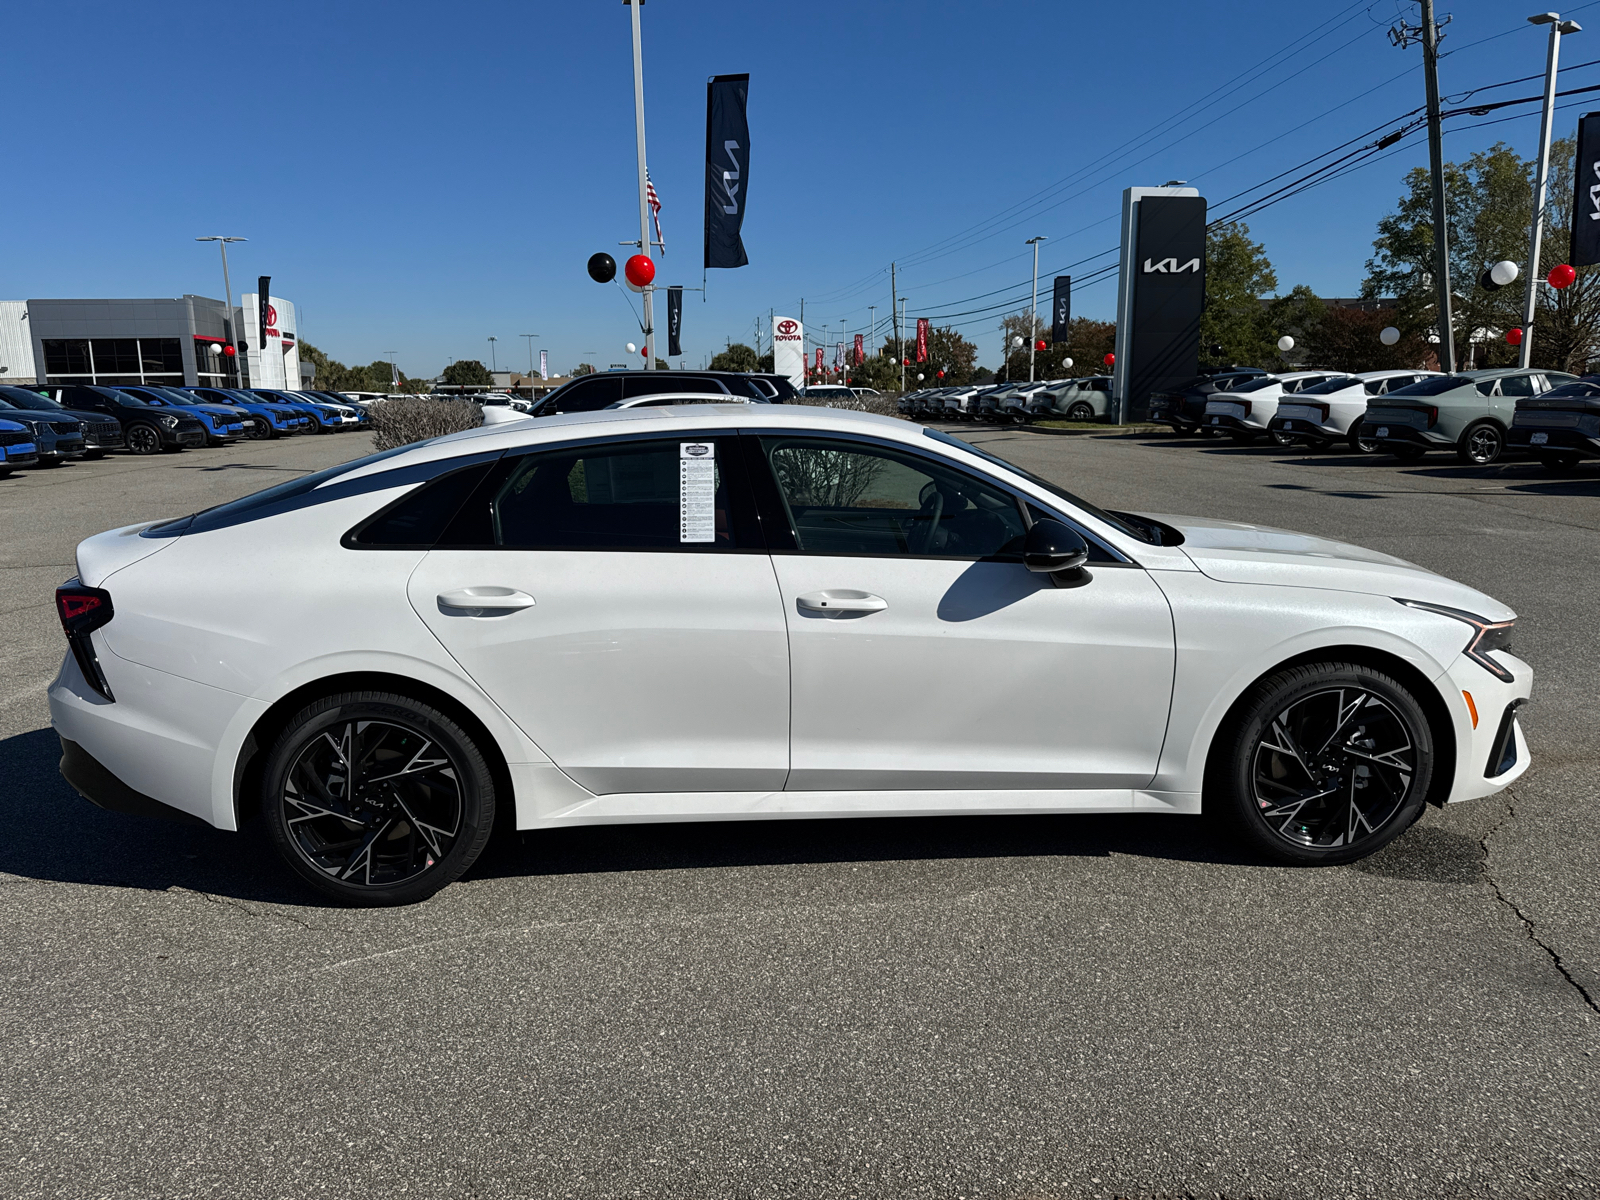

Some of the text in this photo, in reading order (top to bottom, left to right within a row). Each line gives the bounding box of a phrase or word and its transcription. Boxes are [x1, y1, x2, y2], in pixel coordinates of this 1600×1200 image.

[723, 140, 740, 215] KIA
[1144, 257, 1200, 273] KIA
[775, 334, 802, 342] TOYOTA
